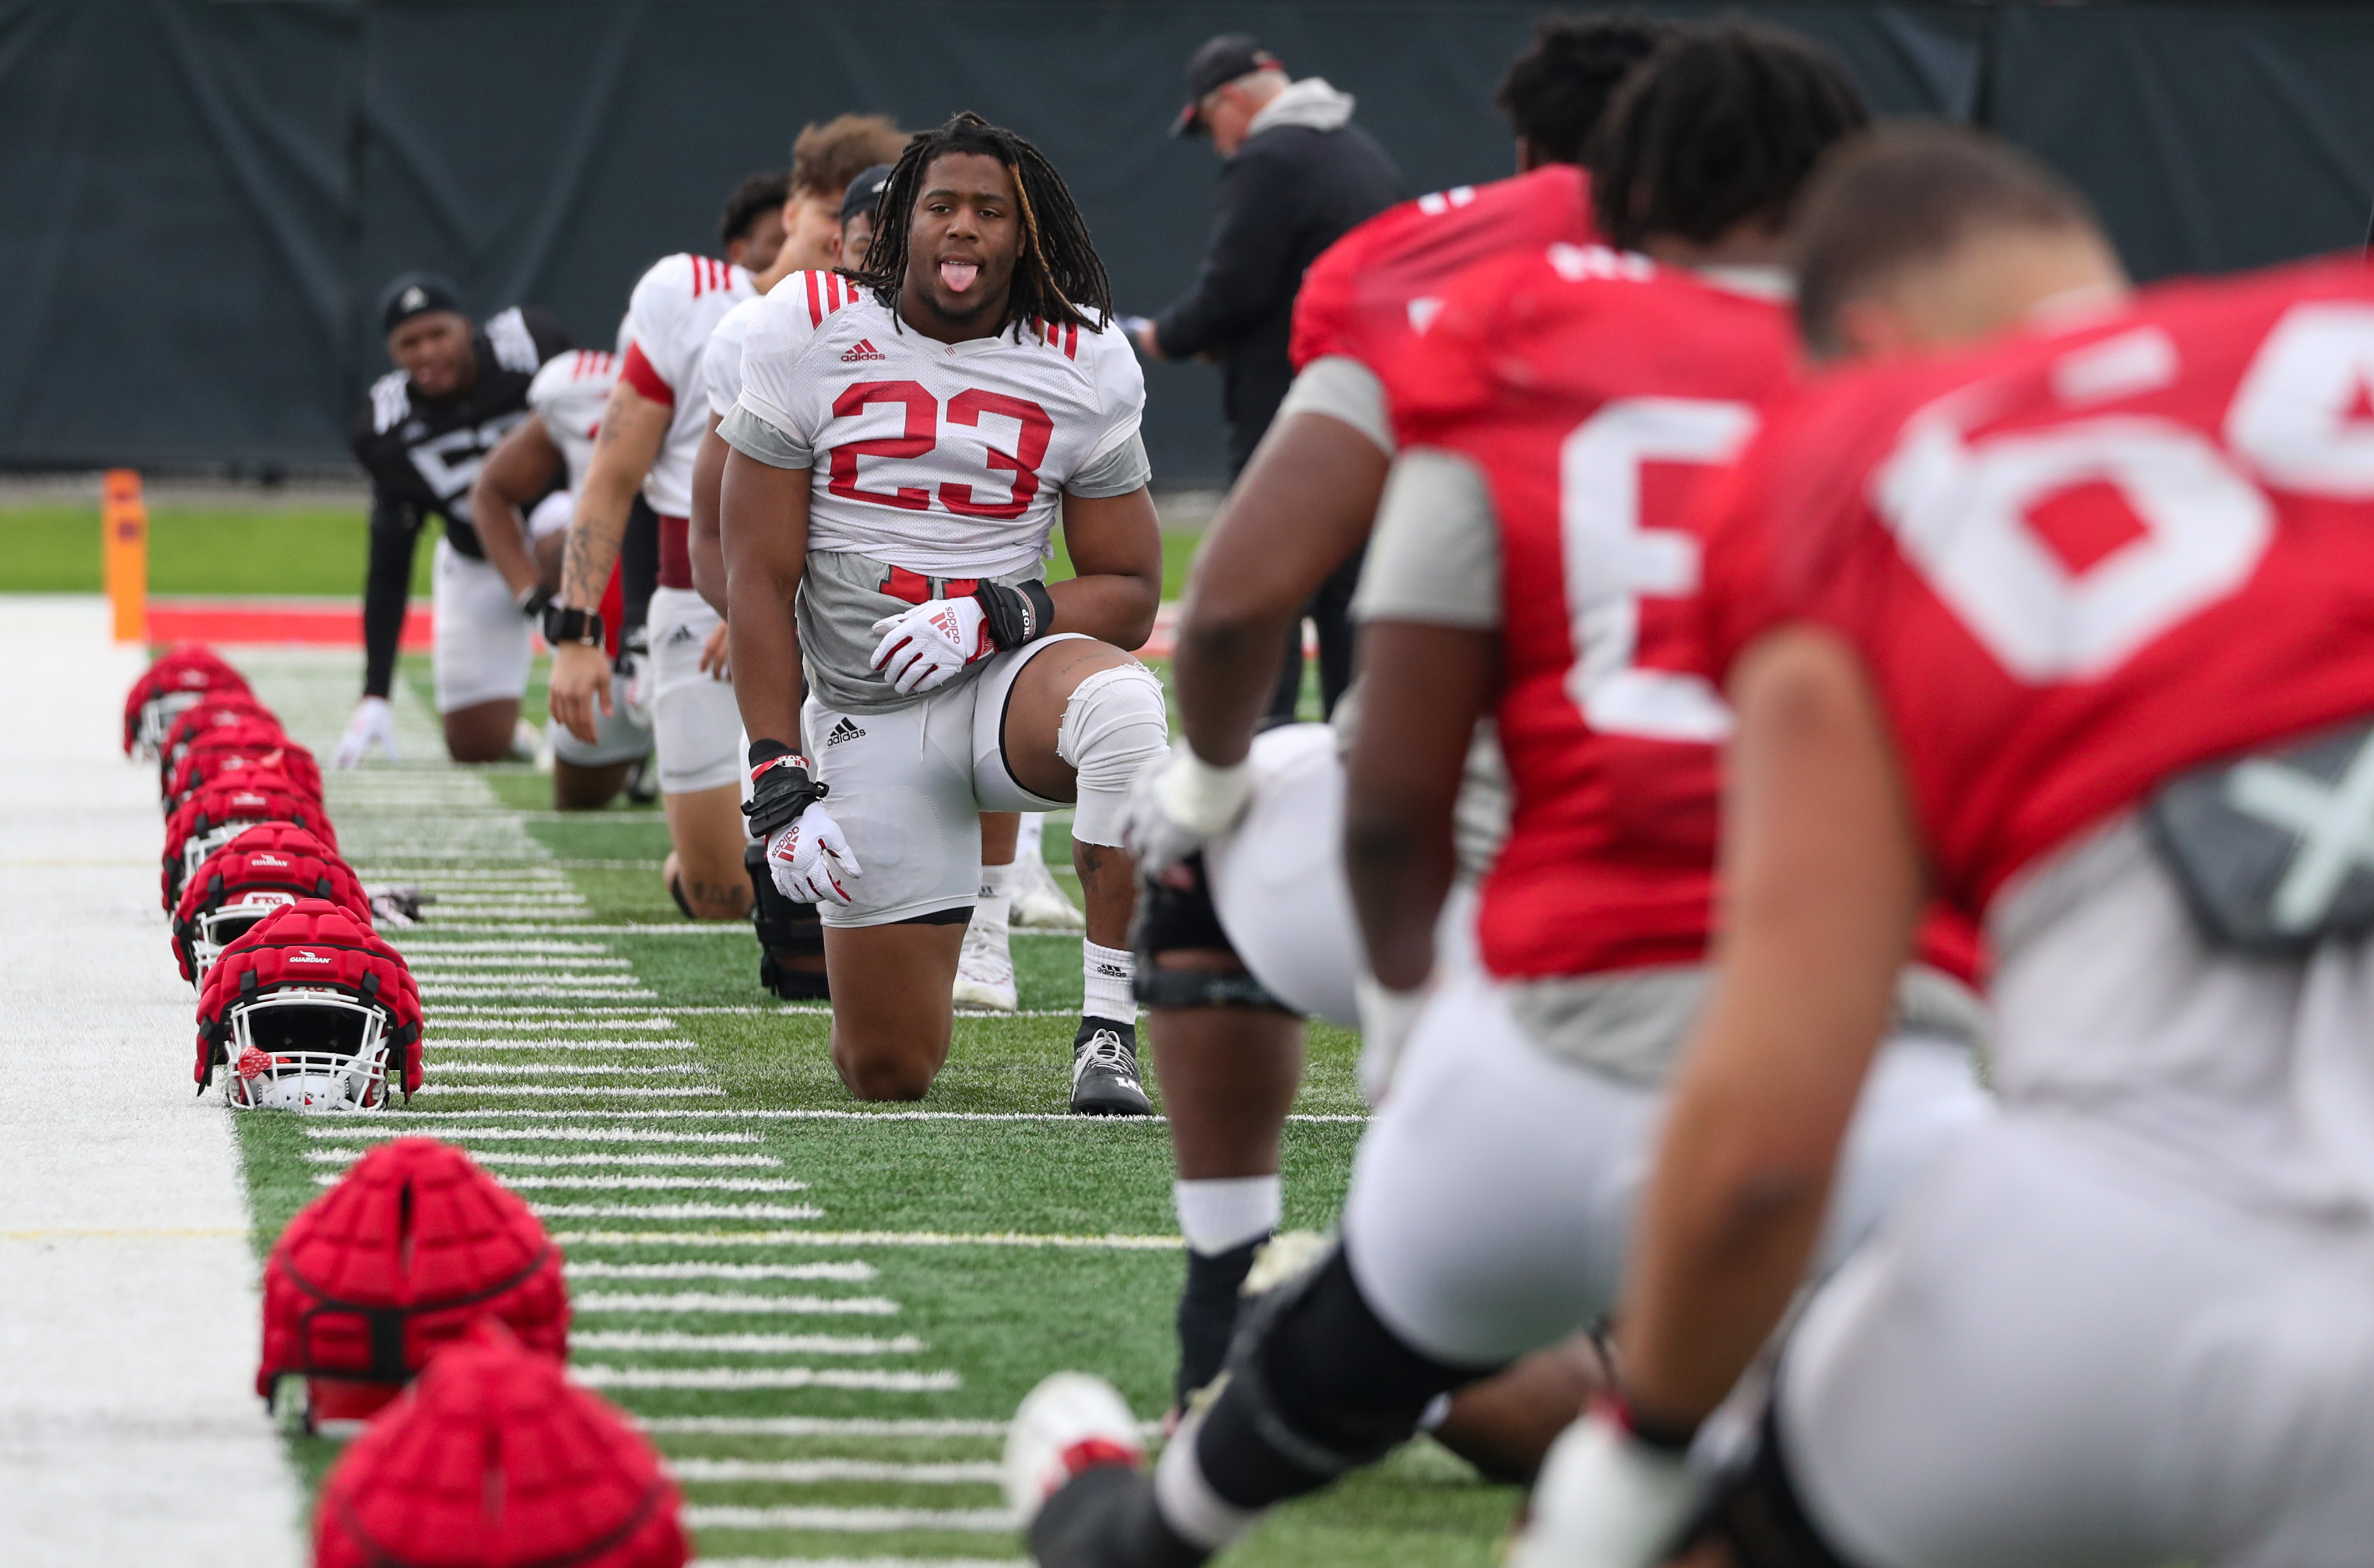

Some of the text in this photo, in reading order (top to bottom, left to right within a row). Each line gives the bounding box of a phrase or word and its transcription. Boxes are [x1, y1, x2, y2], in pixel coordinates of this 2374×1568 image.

[840, 353, 885, 362] adidas
[829, 379, 1054, 520] 23
[945, 607, 961, 644] adidas
[827, 729, 866, 746] adidas
[772, 826, 799, 858] adidas
[1097, 967, 1127, 978] adidas
